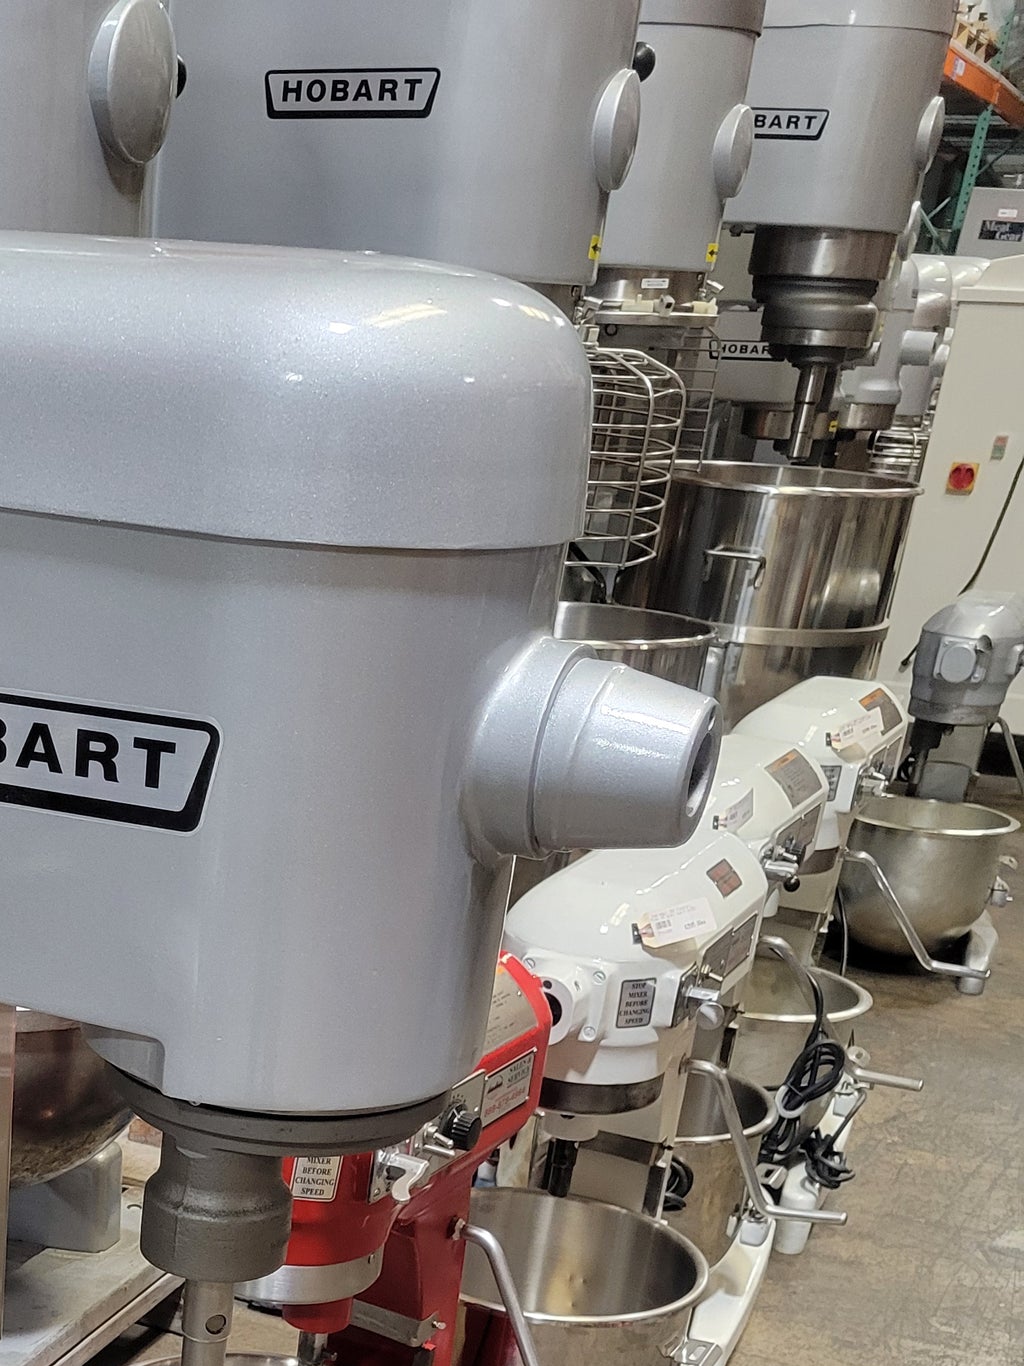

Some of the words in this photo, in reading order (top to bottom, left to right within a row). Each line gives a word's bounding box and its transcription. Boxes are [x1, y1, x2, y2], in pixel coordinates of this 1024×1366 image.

[282, 78, 423, 103] HOBART
[753, 114, 818, 130] BART
[721, 343, 770, 355] HOBAR
[307, 1156, 332, 1165] MIXER
[302, 1166, 333, 1176] BEFORE
[295, 1176, 335, 1186] CHANGING
[301, 1187, 325, 1196] SPEED
